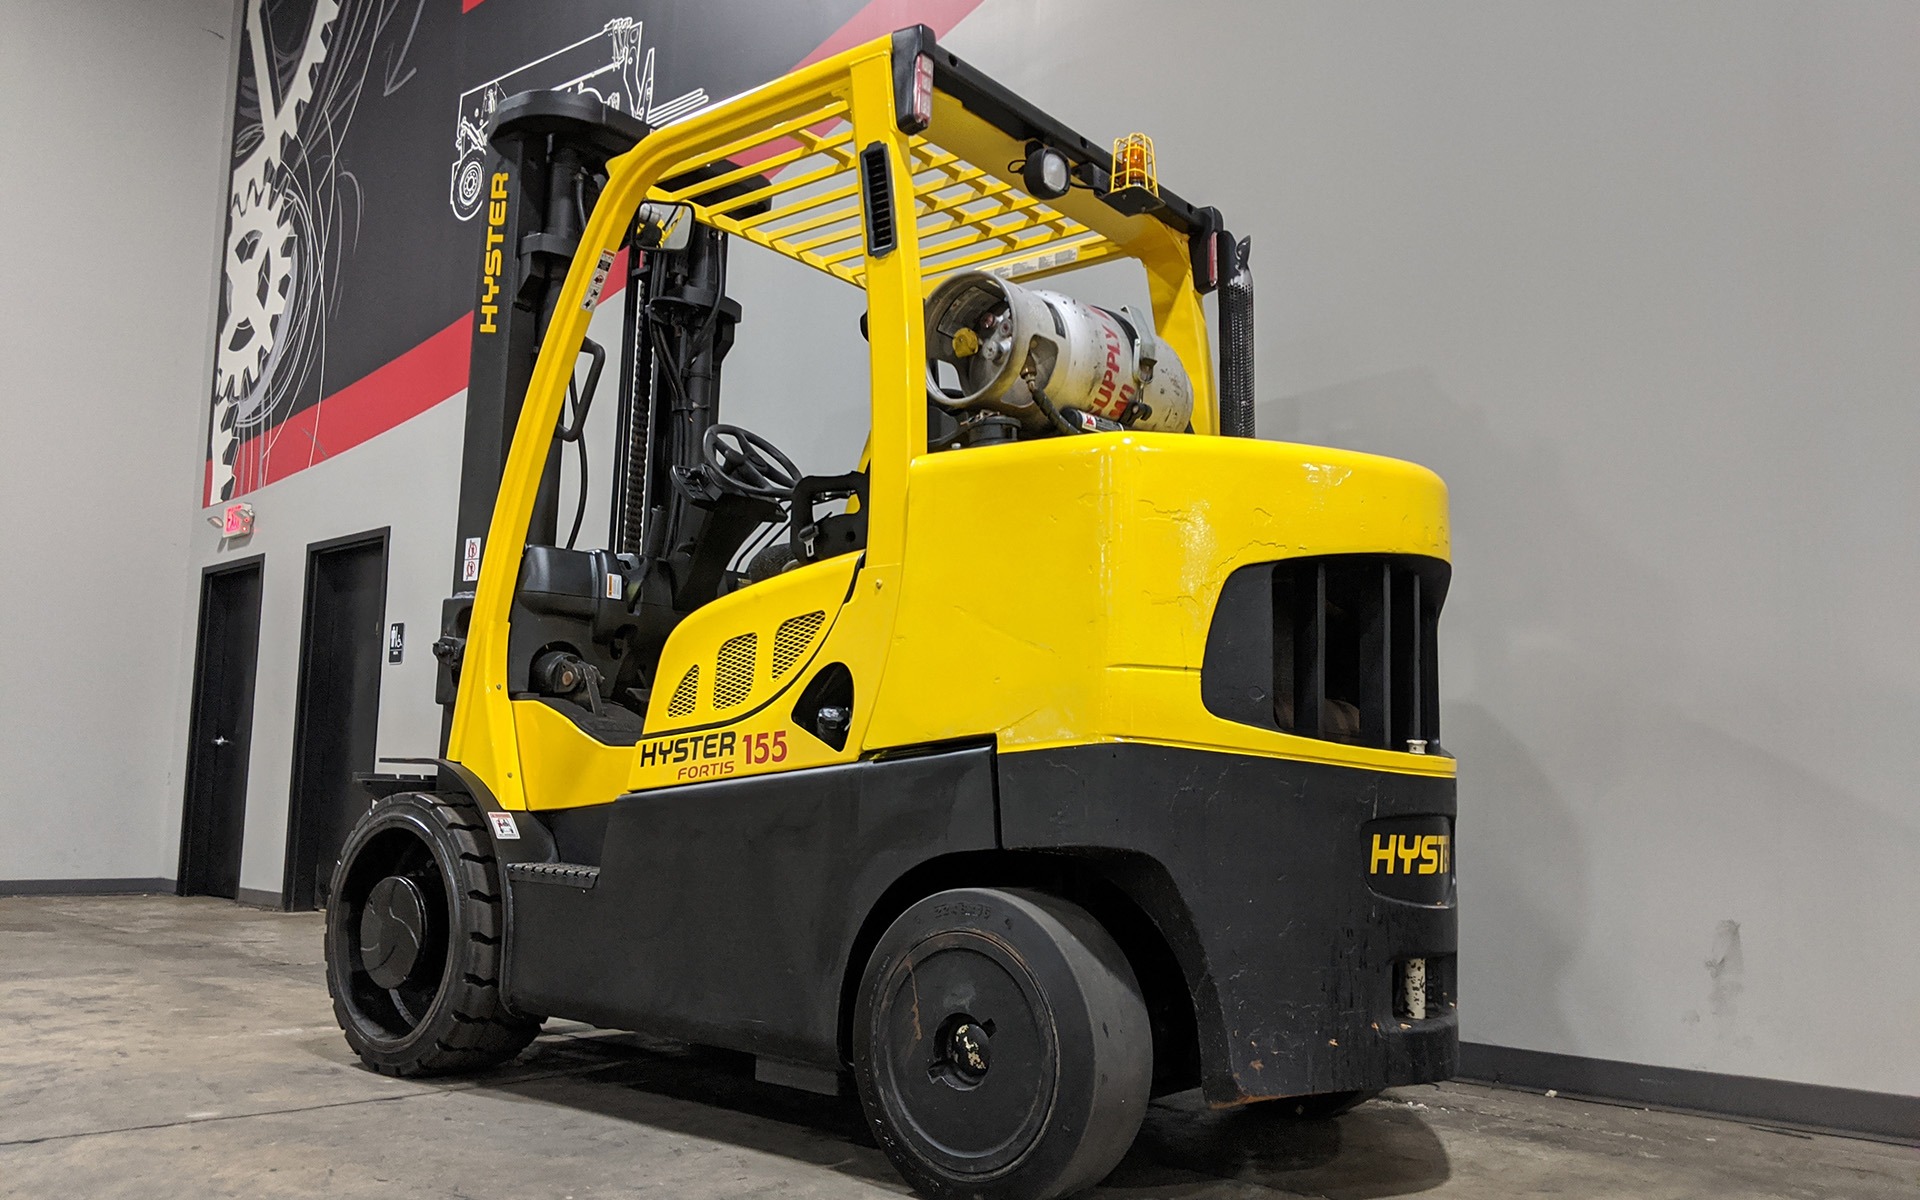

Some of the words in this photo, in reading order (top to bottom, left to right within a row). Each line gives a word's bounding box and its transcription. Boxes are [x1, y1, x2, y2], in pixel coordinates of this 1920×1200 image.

[480, 173, 509, 333] HYSTER
[640, 731, 736, 767] HYSTER
[742, 730, 787, 764] 155
[677, 760, 734, 780] FORTIS
